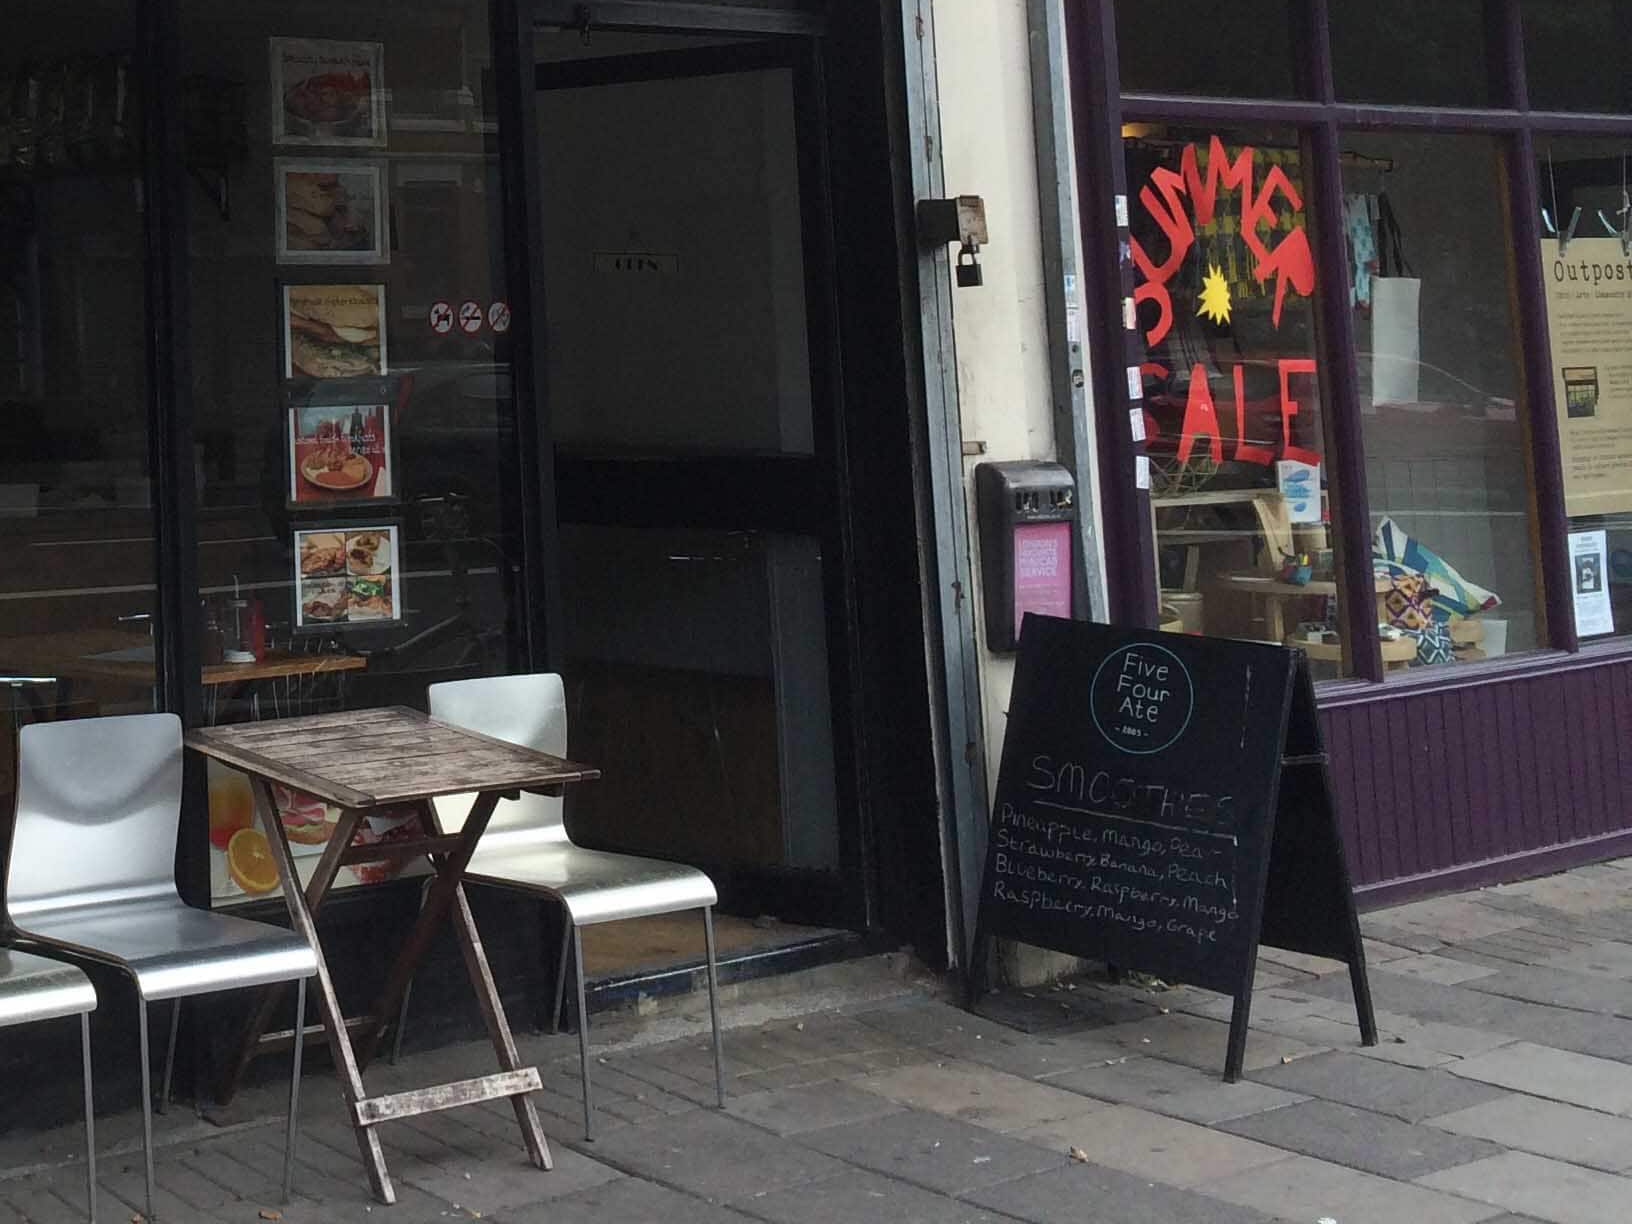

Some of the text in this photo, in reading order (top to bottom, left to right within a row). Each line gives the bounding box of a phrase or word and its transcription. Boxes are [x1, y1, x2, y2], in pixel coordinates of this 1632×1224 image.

[1554, 260, 1632, 285] Outpost
[1123, 652, 1169, 681] Five
[1116, 674, 1170, 703] Four
[1119, 696, 1159, 722] Ate
